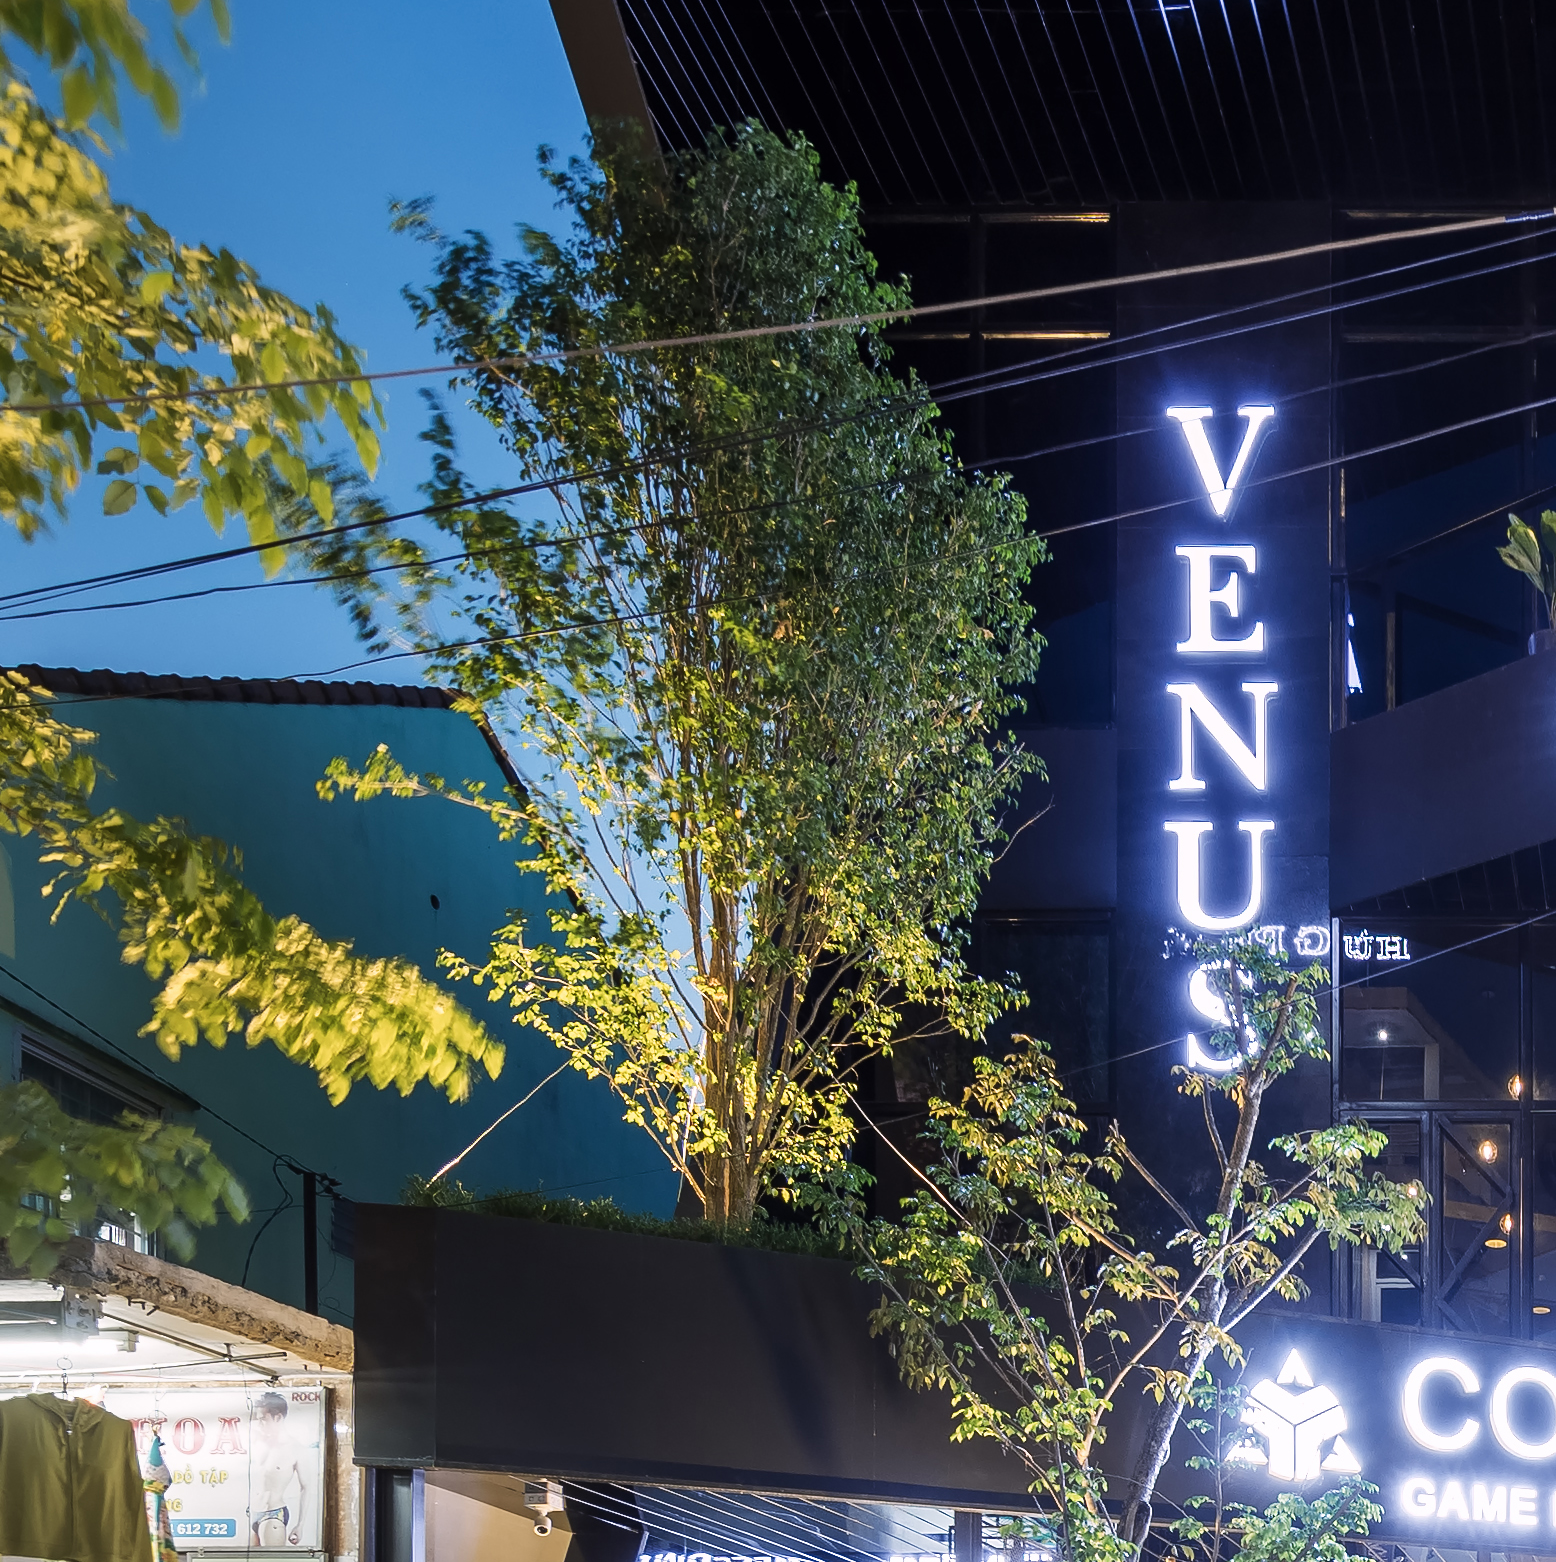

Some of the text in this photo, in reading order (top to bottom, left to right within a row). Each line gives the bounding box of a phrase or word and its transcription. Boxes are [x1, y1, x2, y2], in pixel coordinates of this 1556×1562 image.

[1164, 405, 1278, 1071] VENUS
[1400, 1478, 1539, 1527] GAME
[177, 1523, 201, 1535] 612
[204, 1523, 228, 1535] 732
